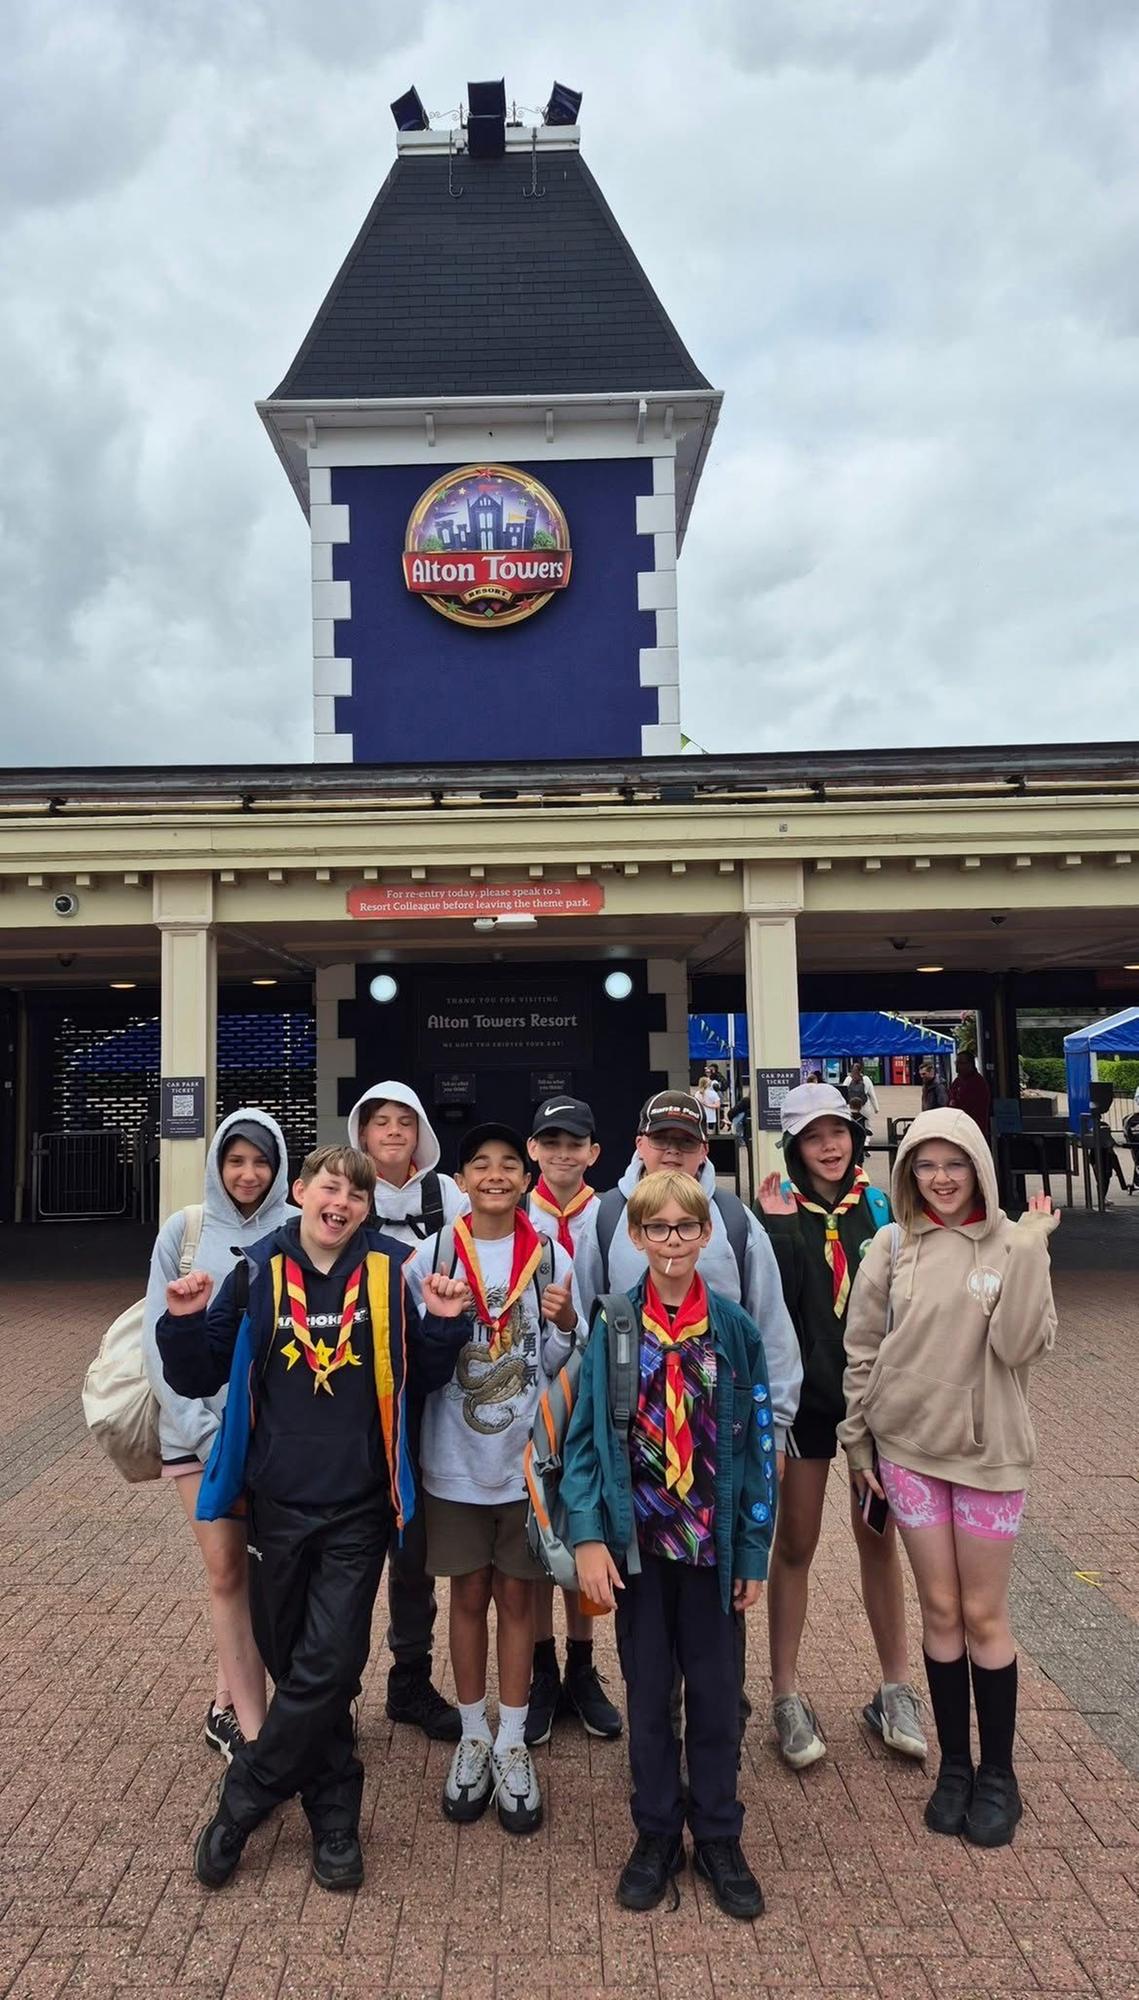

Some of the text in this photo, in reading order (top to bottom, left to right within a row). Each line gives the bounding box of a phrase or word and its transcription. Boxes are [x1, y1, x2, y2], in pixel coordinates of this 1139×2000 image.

[412, 555, 563, 583] Alton Towers
[468, 587, 508, 599] RESORT
[386, 889, 403, 899] For
[405, 889, 445, 900] re-entry
[448, 888, 478, 899] today,
[480, 887, 510, 898] please
[513, 887, 541, 897] speak
[543, 887, 552, 896] to
[360, 897, 591, 913] Resort Colleague before leaving the theme park.
[427, 1013, 578, 1029] Alton Towers Resort
[650, 1105, 681, 1115] Santa
